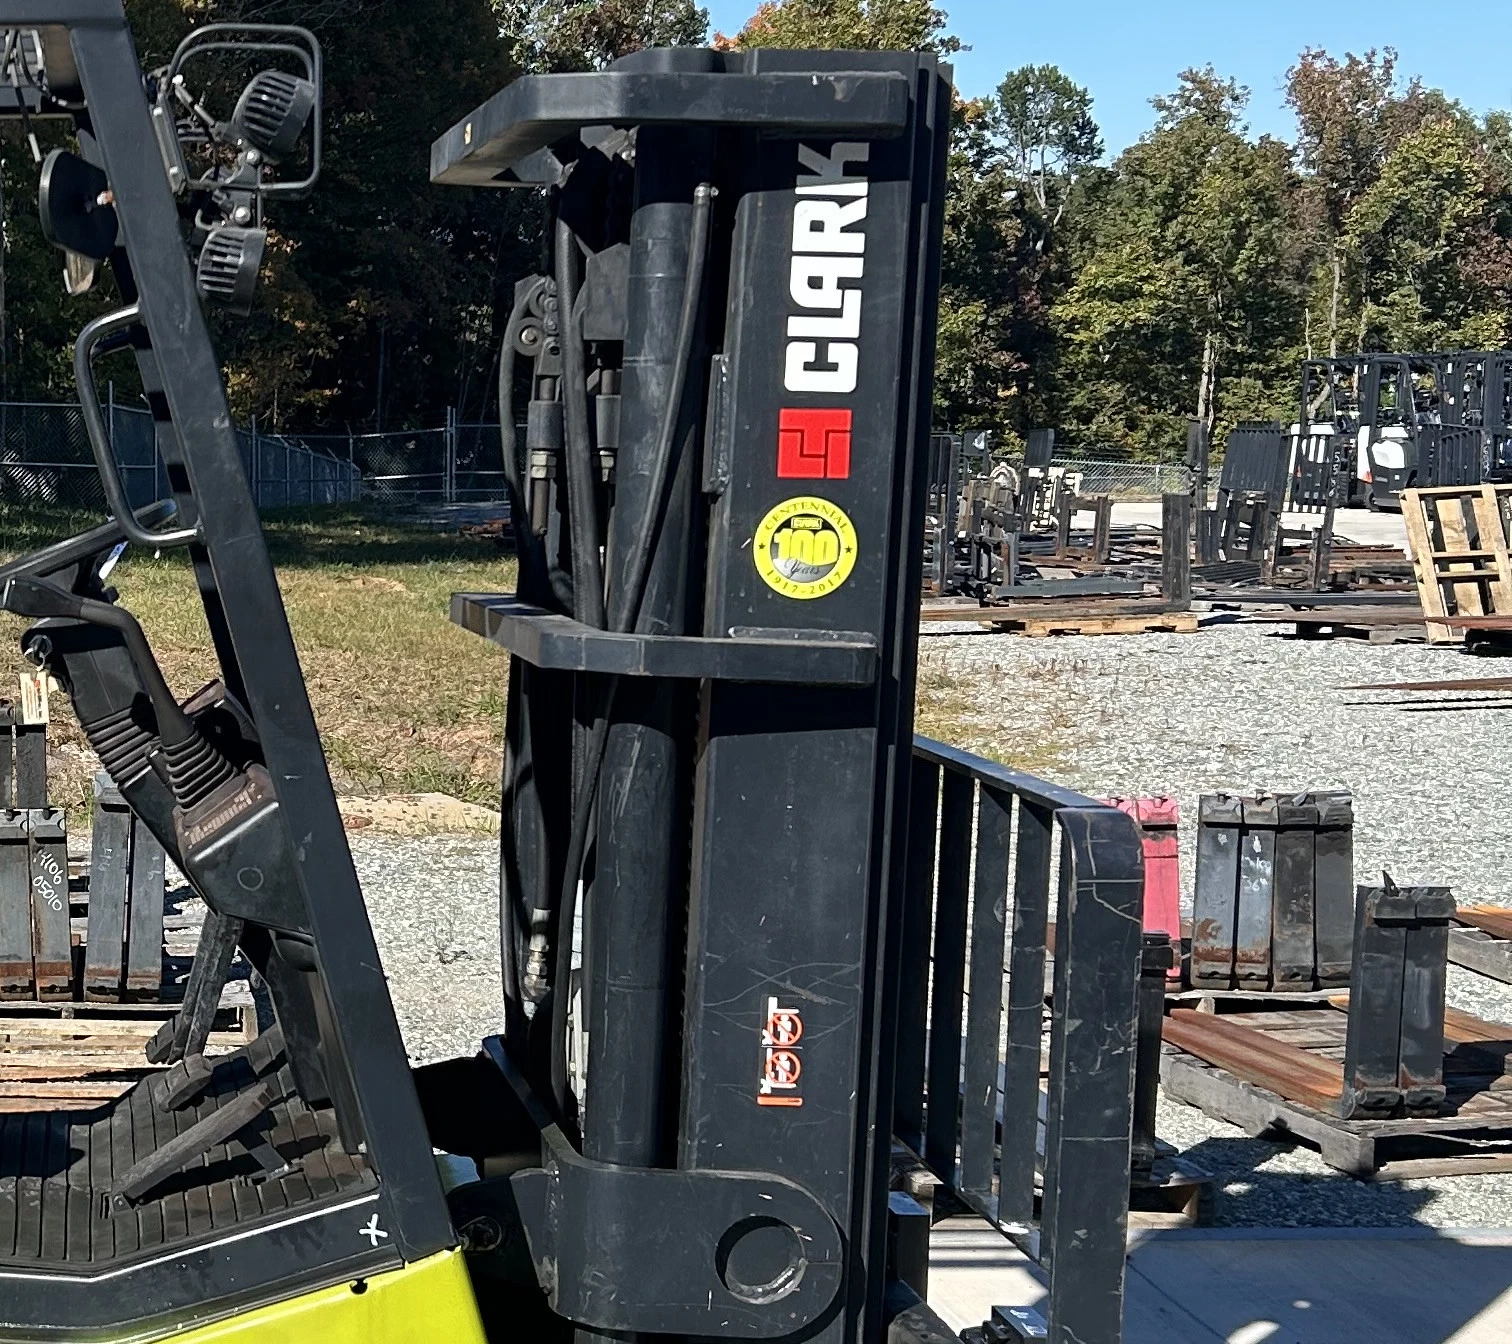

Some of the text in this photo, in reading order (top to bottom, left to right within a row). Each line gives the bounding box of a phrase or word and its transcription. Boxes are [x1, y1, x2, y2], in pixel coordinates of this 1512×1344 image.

[783, 142, 870, 393] CLARK
[764, 501, 849, 535] CENTENNIAL
[774, 527, 840, 567] 100
[766, 568, 843, 595] 1917-2017
